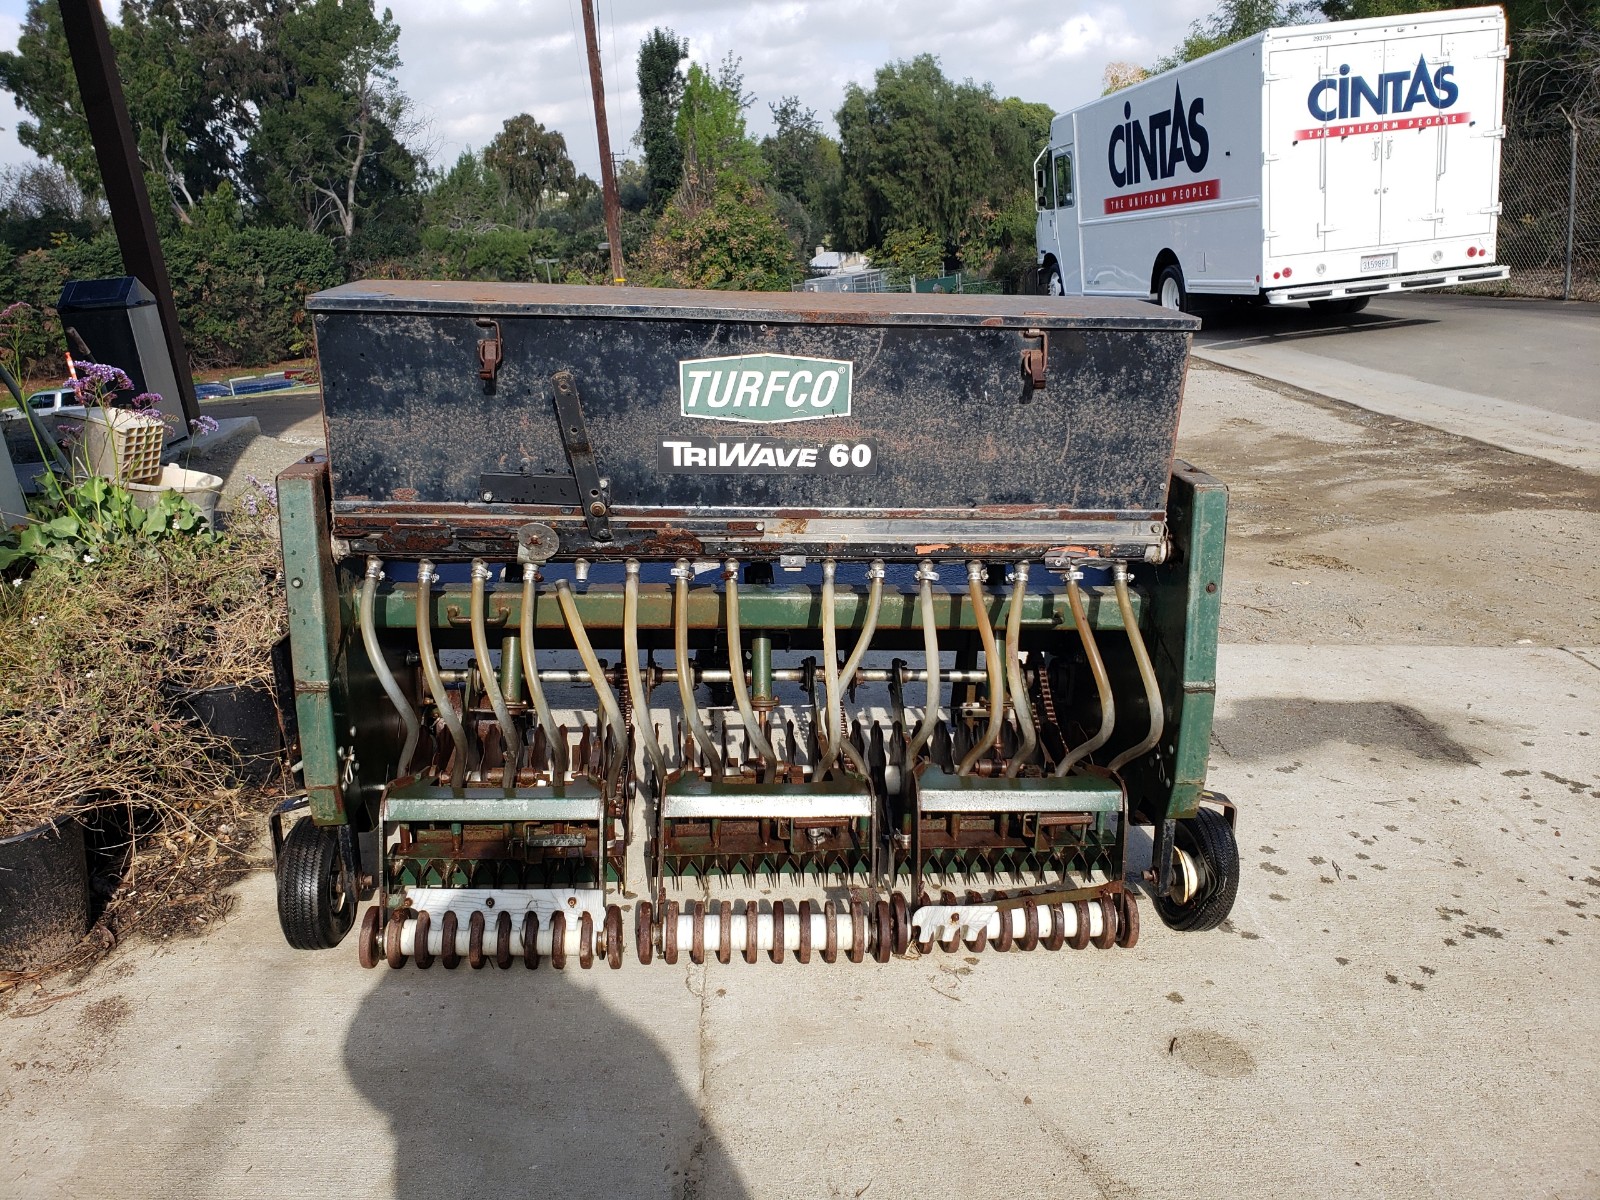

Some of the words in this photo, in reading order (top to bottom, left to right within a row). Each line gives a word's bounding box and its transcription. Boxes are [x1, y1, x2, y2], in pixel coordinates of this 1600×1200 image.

[1308, 128, 1330, 138] THE
[1340, 121, 1399, 134] UNIFORM
[1110, 199, 1124, 210] THE
[1128, 192, 1167, 208] UNIFORM
[1172, 185, 1210, 201] PEOPLE
[687, 370, 840, 408] TURFCO
[828, 444, 873, 468] 60
